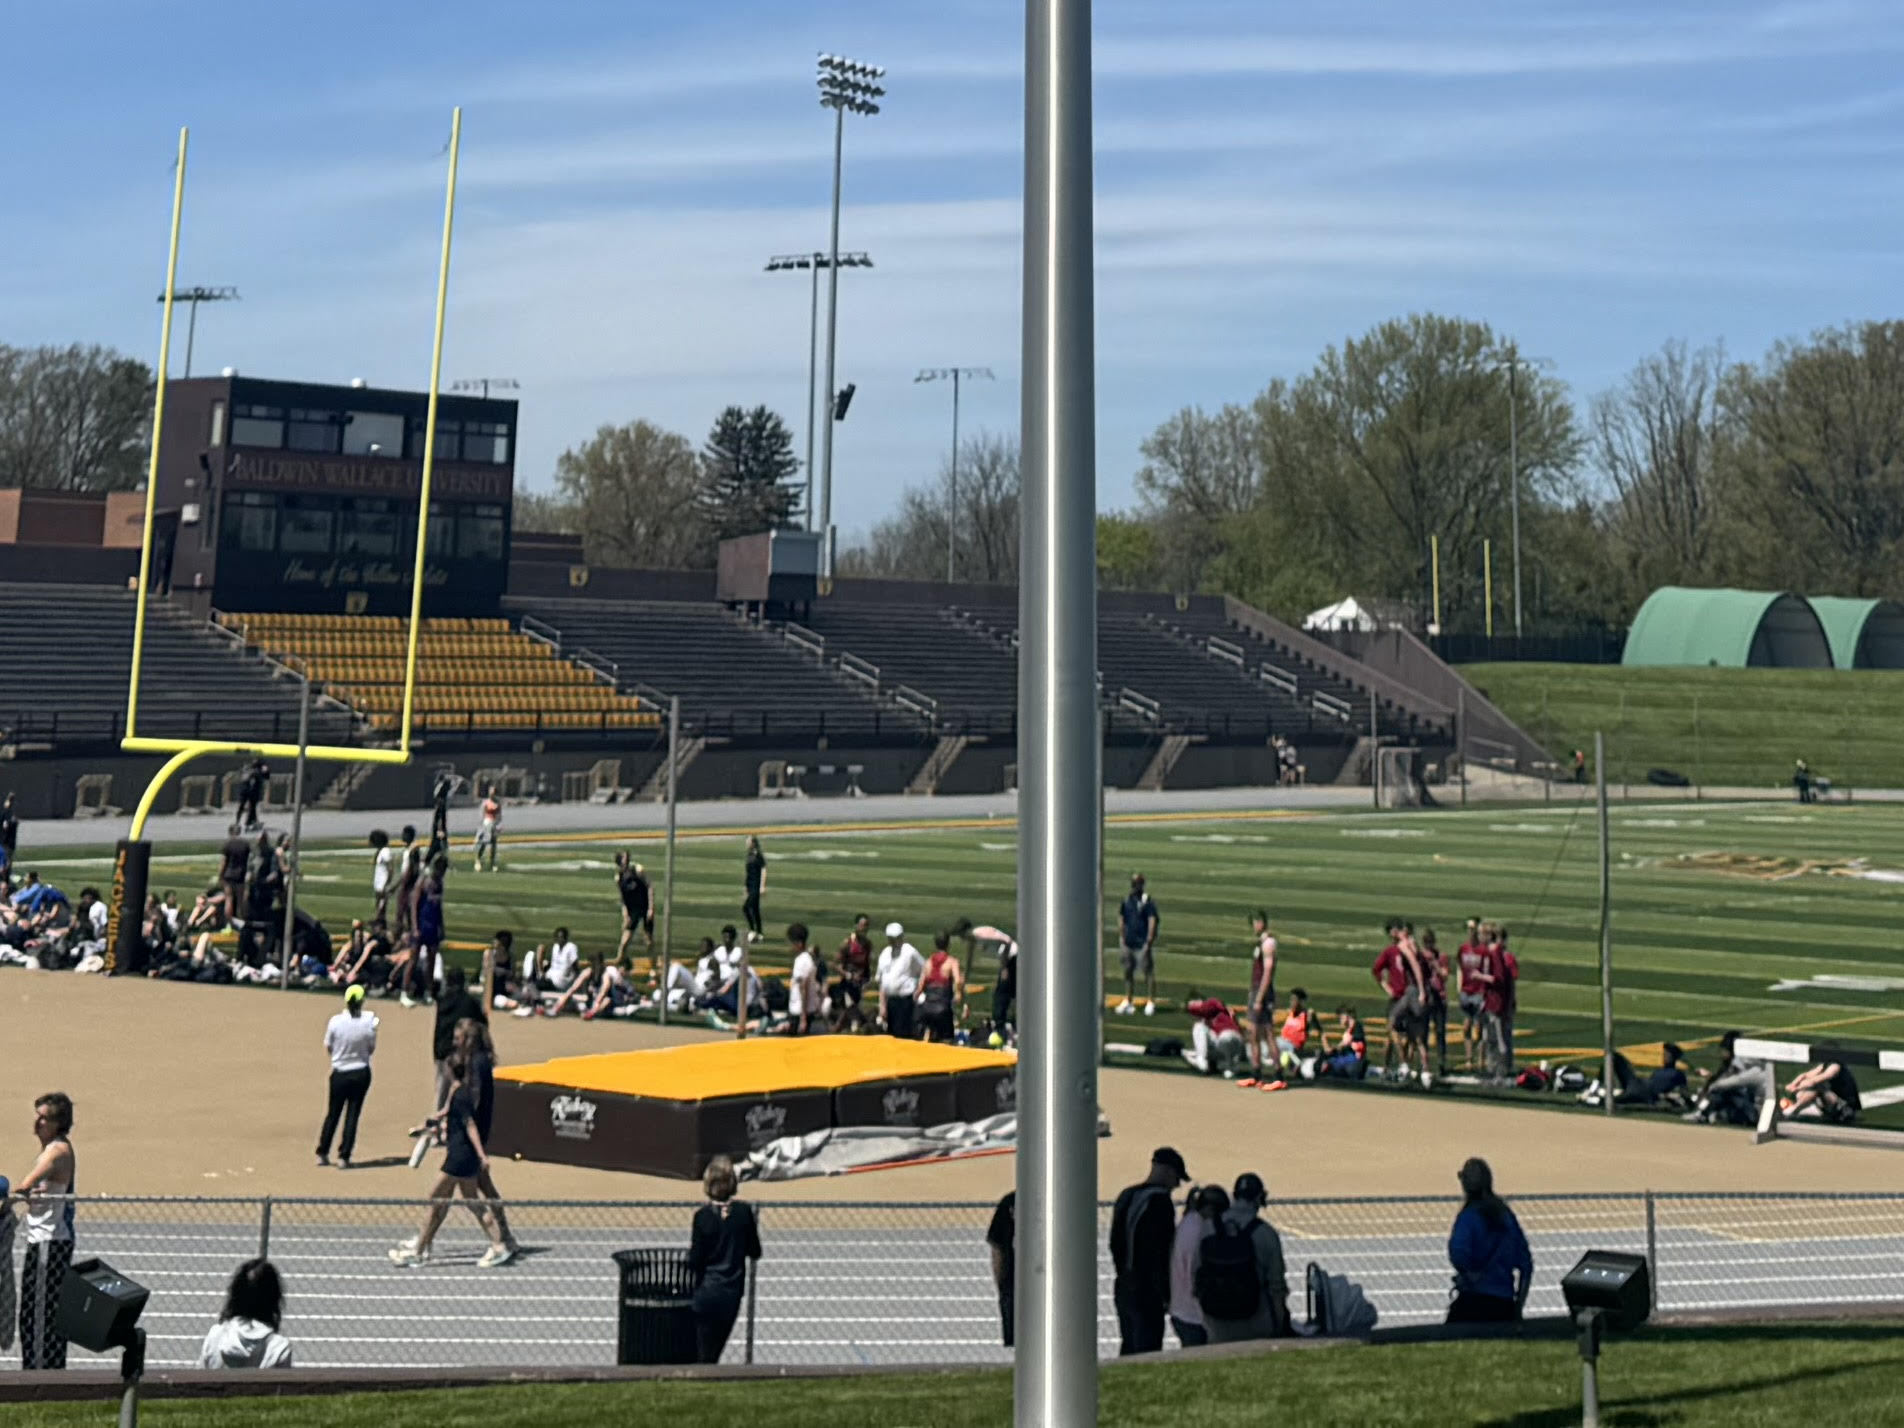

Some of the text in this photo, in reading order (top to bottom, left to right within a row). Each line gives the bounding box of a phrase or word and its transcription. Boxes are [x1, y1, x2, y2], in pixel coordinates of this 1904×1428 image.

[234, 456, 505, 498] BALDWIN WALLACE UIVERSITY
[103, 848, 126, 971] JACKETS
